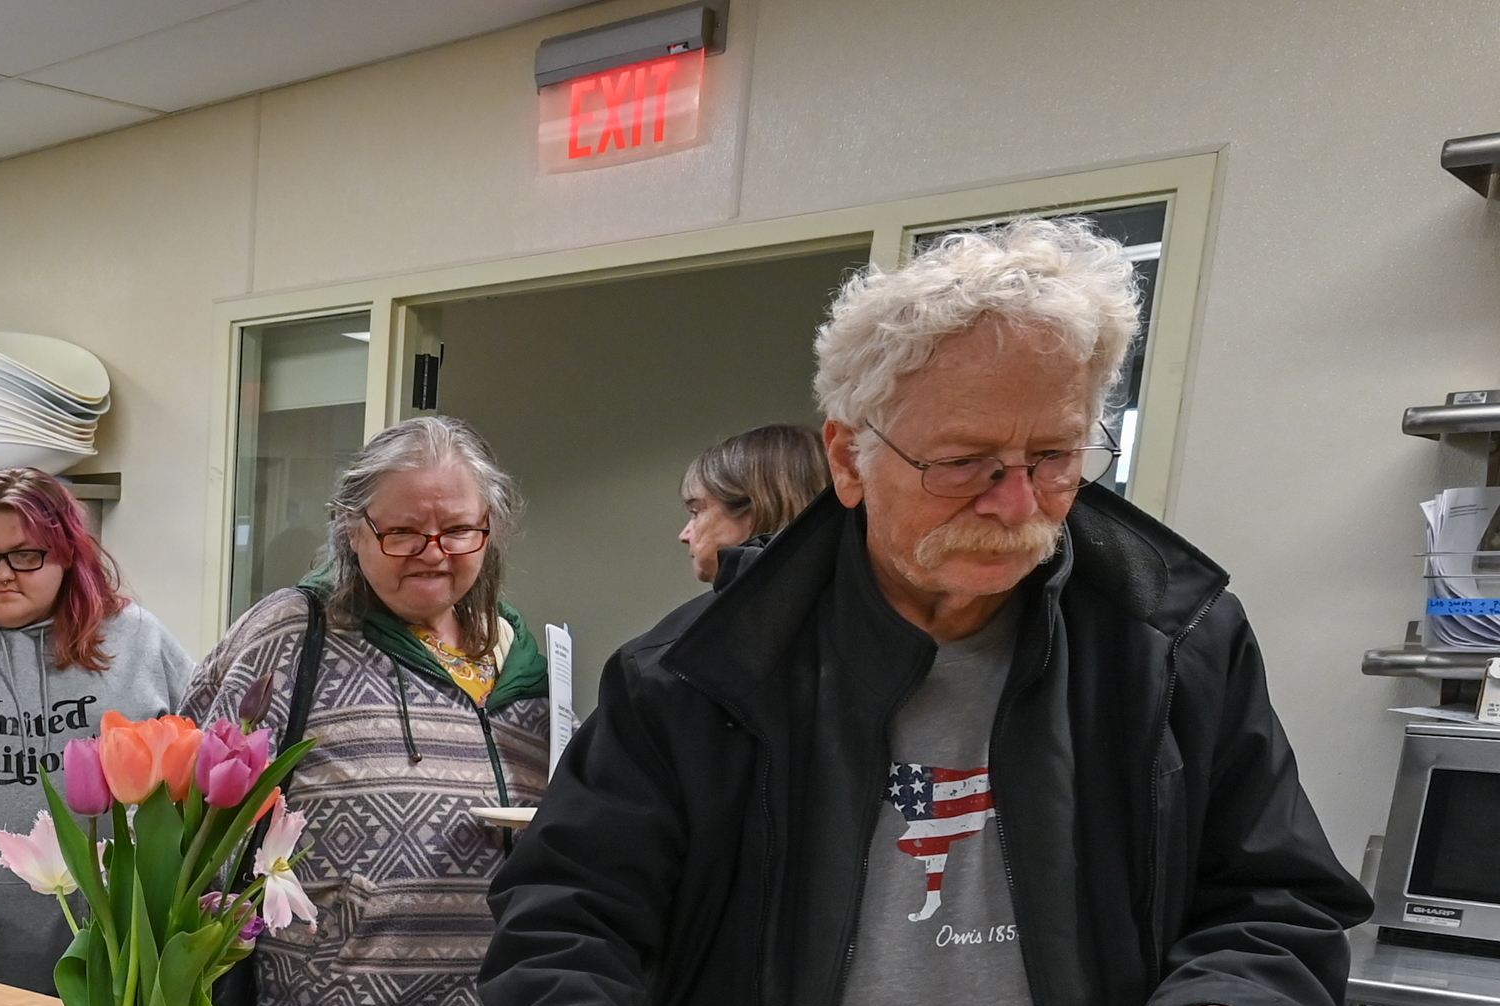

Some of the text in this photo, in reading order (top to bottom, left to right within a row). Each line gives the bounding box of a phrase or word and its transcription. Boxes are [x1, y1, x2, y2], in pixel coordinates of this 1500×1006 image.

[569, 60, 677, 159] EXIT
[1413, 906, 1455, 916] SHARP
[936, 924, 1019, 947] Orvis 185
